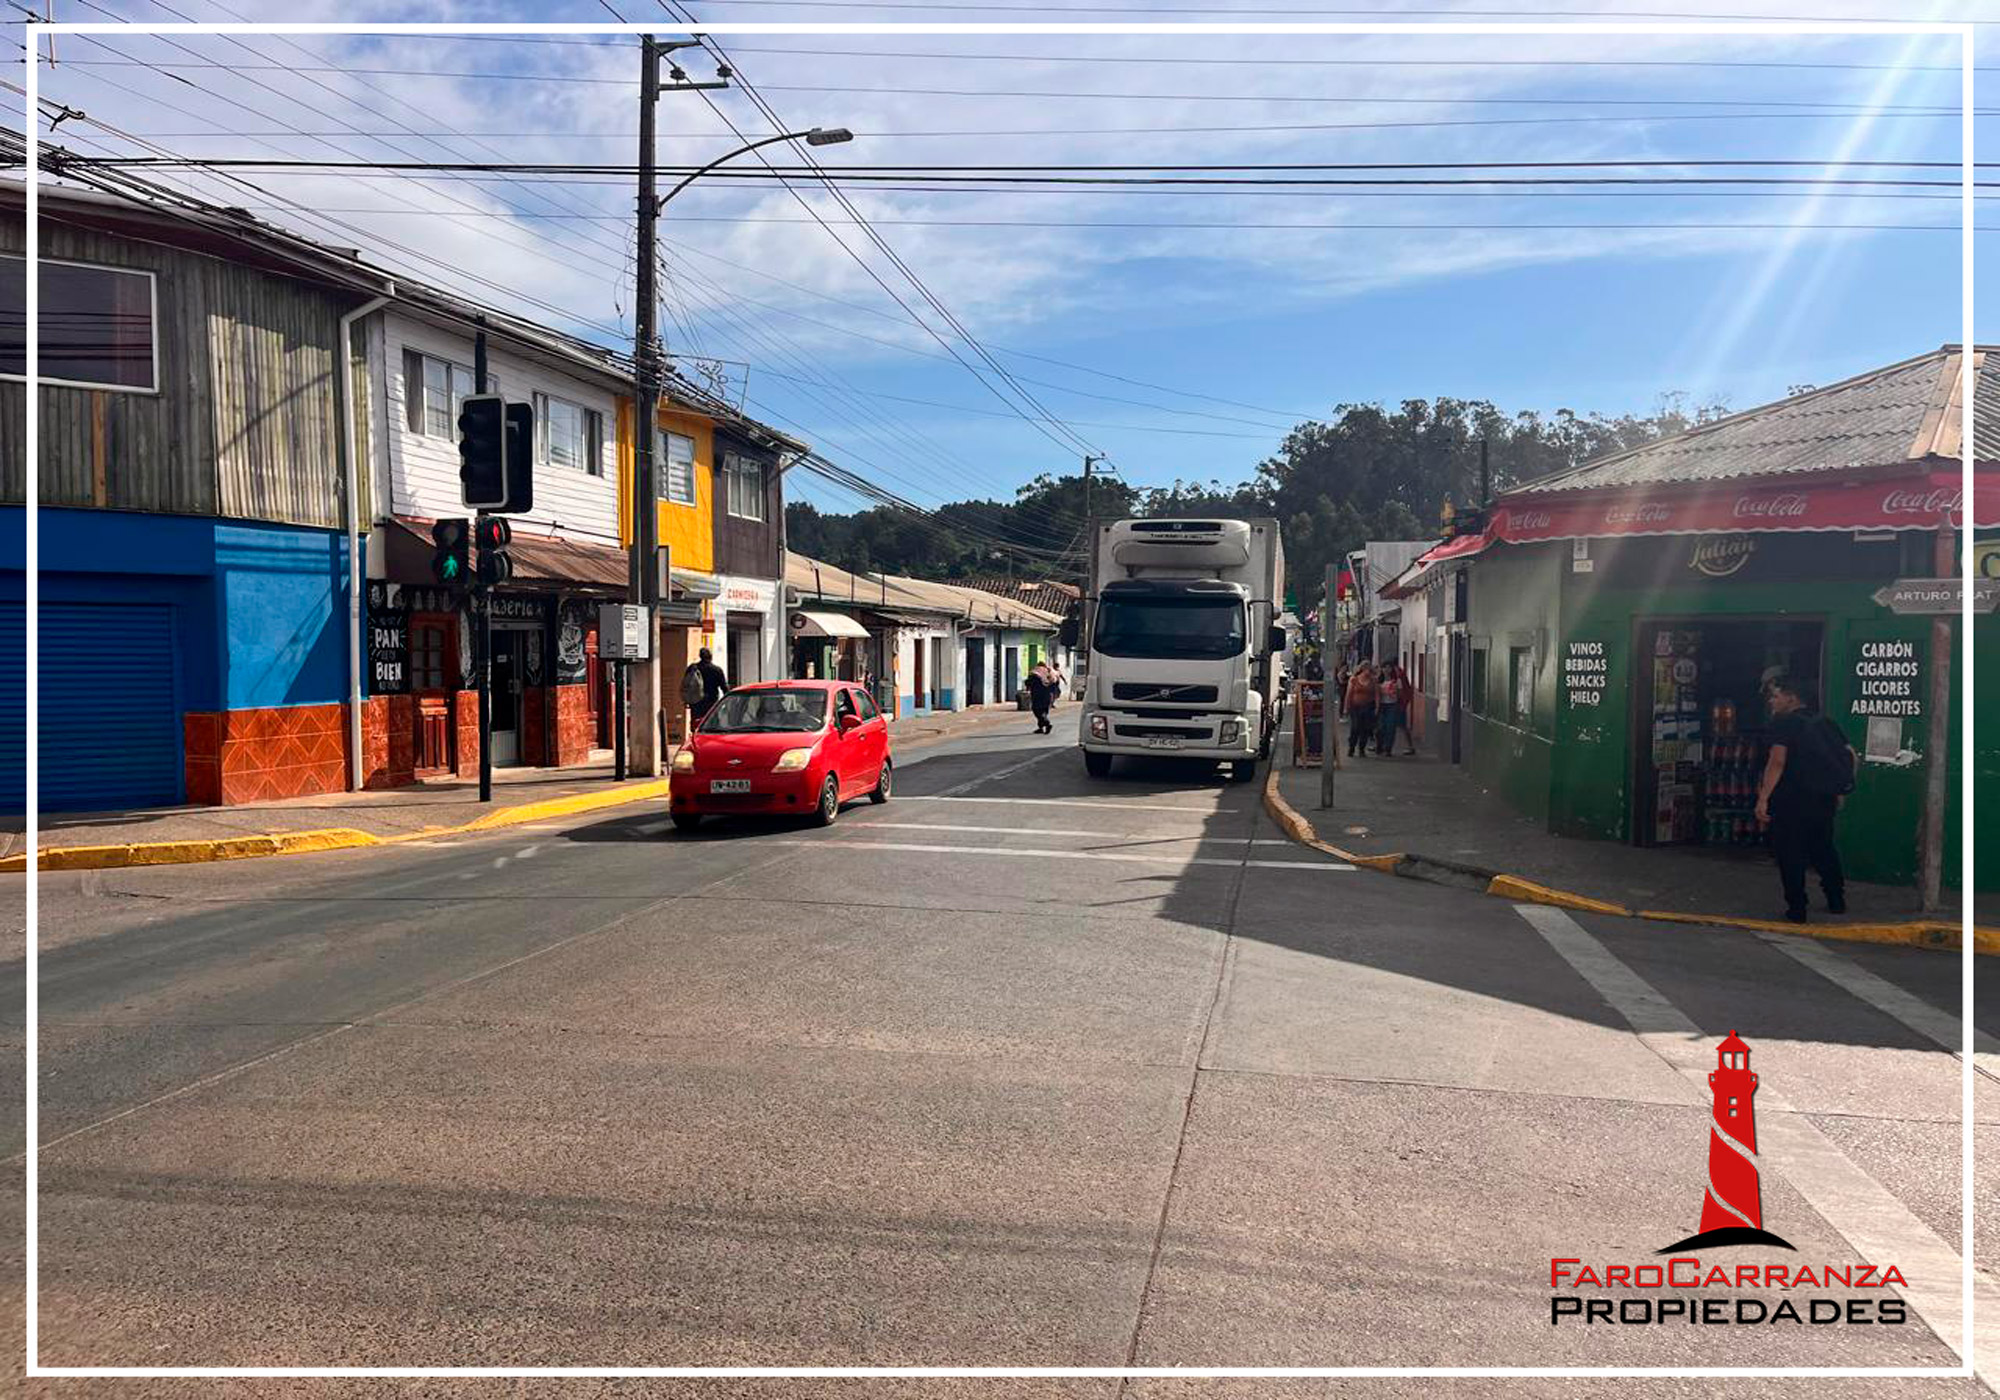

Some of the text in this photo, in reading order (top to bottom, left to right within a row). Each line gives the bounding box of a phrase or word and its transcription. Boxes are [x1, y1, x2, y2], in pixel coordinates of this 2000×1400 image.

[1733, 494, 1808, 517] Coca-Cola
[1895, 591, 1951, 601] ARTURO
[374, 628, 400, 649] PAN
[1569, 642, 1603, 656] VINOS
[1861, 639, 1914, 658] CARBÓN
[375, 661, 402, 681] BIEN
[1565, 658, 1608, 672] BEBIDAS
[1855, 661, 1919, 677] CIGARROS
[1565, 674, 1606, 688] SNACKS
[1861, 680, 1911, 696] LICORES
[1569, 690, 1601, 704] HIELO
[1850, 699, 1921, 715] ABARROTES
